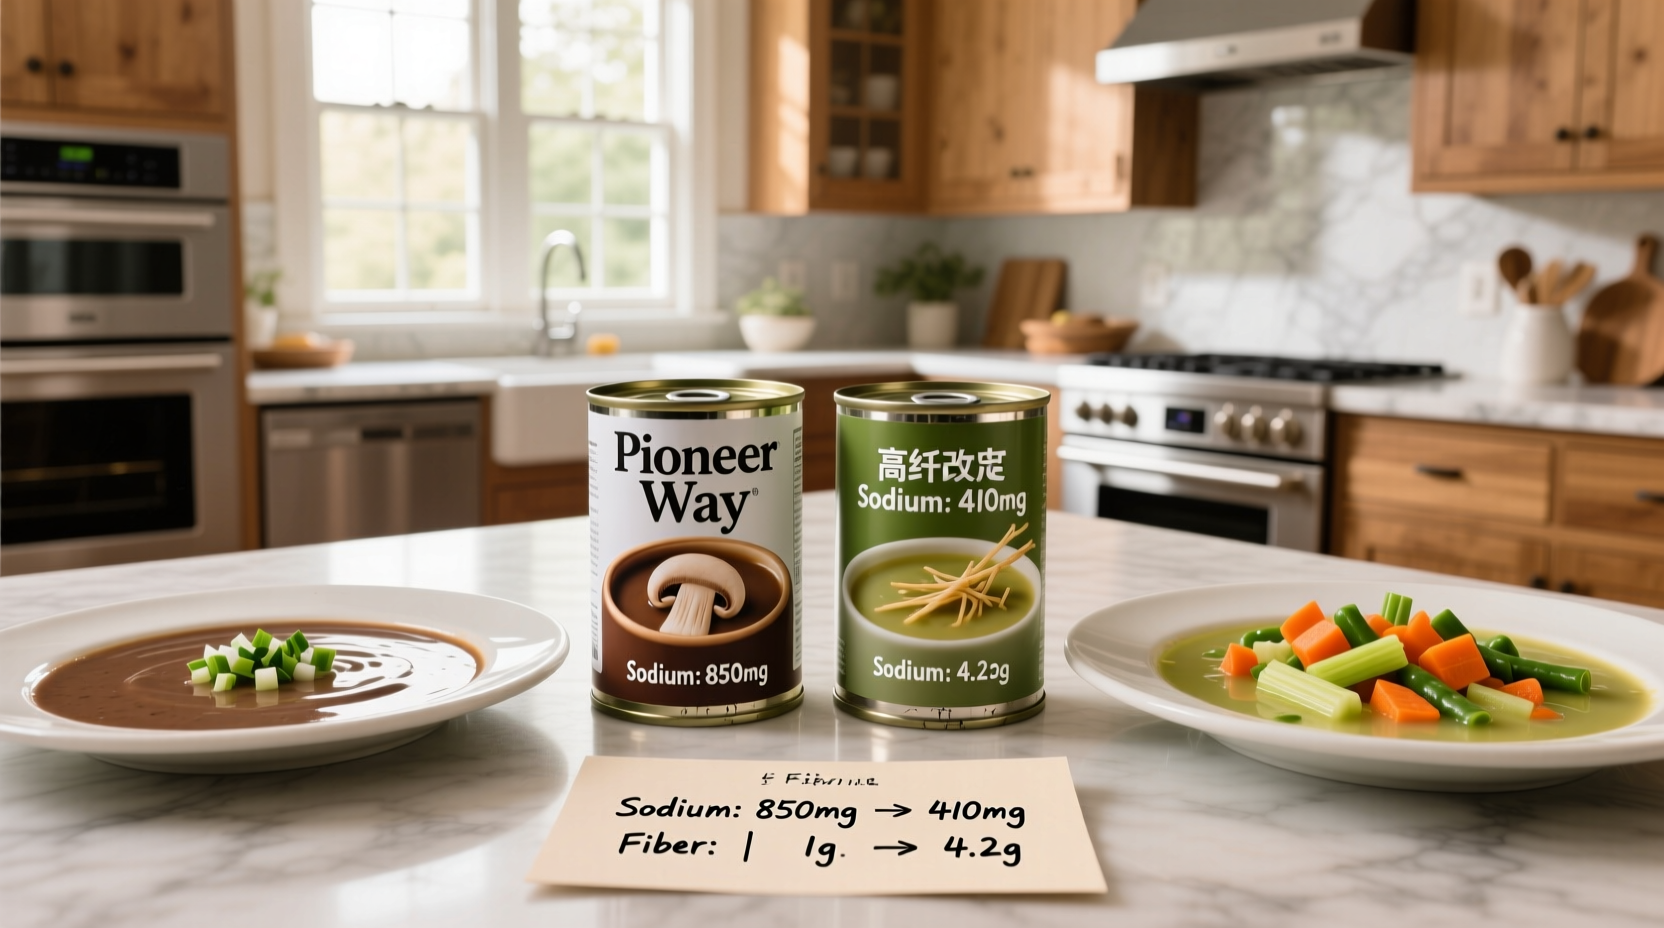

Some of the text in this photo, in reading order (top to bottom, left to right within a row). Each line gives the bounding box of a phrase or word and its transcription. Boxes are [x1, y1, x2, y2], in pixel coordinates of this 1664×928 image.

[614, 431, 777, 475] Pioneer
[858, 484, 1027, 517] Sodium: 410mg
[626, 659, 768, 686] Sodium: 850mg
[873, 655, 951, 683] Sodium:
[616, 796, 1025, 828] Sodium: 850mg 410mg
[618, 831, 717, 856] Fiber:
[943, 835, 1021, 868] 4.2g
